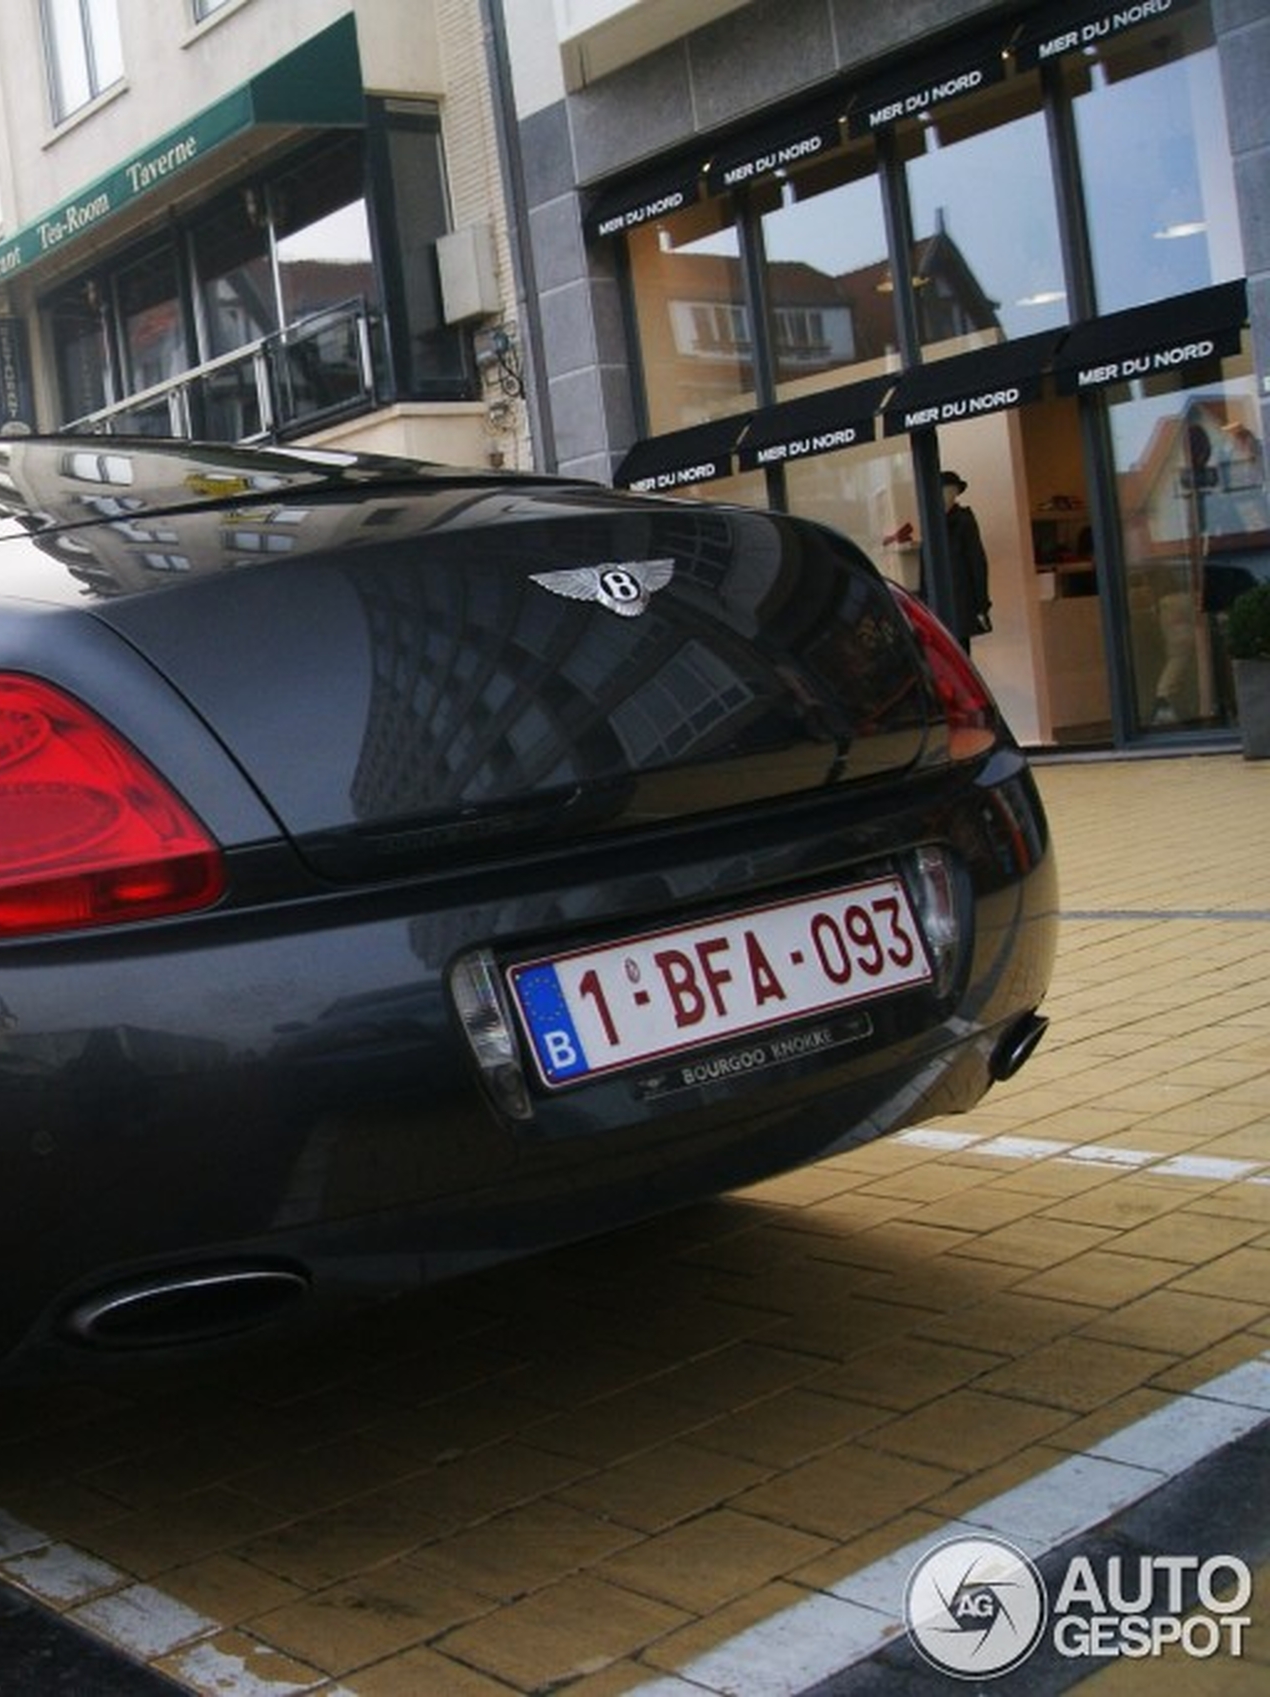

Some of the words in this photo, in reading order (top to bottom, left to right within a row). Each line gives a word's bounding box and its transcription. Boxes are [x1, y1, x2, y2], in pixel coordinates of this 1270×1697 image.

[1039, 31, 1078, 59] MER
[1082, 18, 1110, 41] DU
[1113, 0, 1171, 29] NORD
[869, 101, 905, 127] MER
[906, 91, 930, 112] DU
[932, 70, 983, 99] NORD
[723, 162, 754, 185] MER
[756, 153, 777, 173] DU
[778, 136, 822, 162] NORD
[36, 193, 110, 249] Tea-Room
[125, 136, 197, 192] Taverne
[598, 215, 625, 236] MER
[626, 206, 645, 225] DU
[647, 192, 684, 219] NORD
[1078, 363, 1119, 386] MER
[1121, 356, 1152, 376] DU
[1154, 340, 1215, 369] NORD
[904, 407, 939, 429] MER
[941, 400, 968, 420] DU
[969, 388, 1020, 412] NORD
[757, 446, 788, 464] MER
[789, 439, 811, 456] DU
[812, 428, 857, 451] NORD
[657, 472, 677, 488] DU
[677, 463, 716, 483] NORD
[578, 897, 916, 1047] 1-BFA-093
[543, 1030, 577, 1070] B
[681, 1049, 766, 1086] BOURGOO
[770, 1029, 833, 1063] KNOKKE
